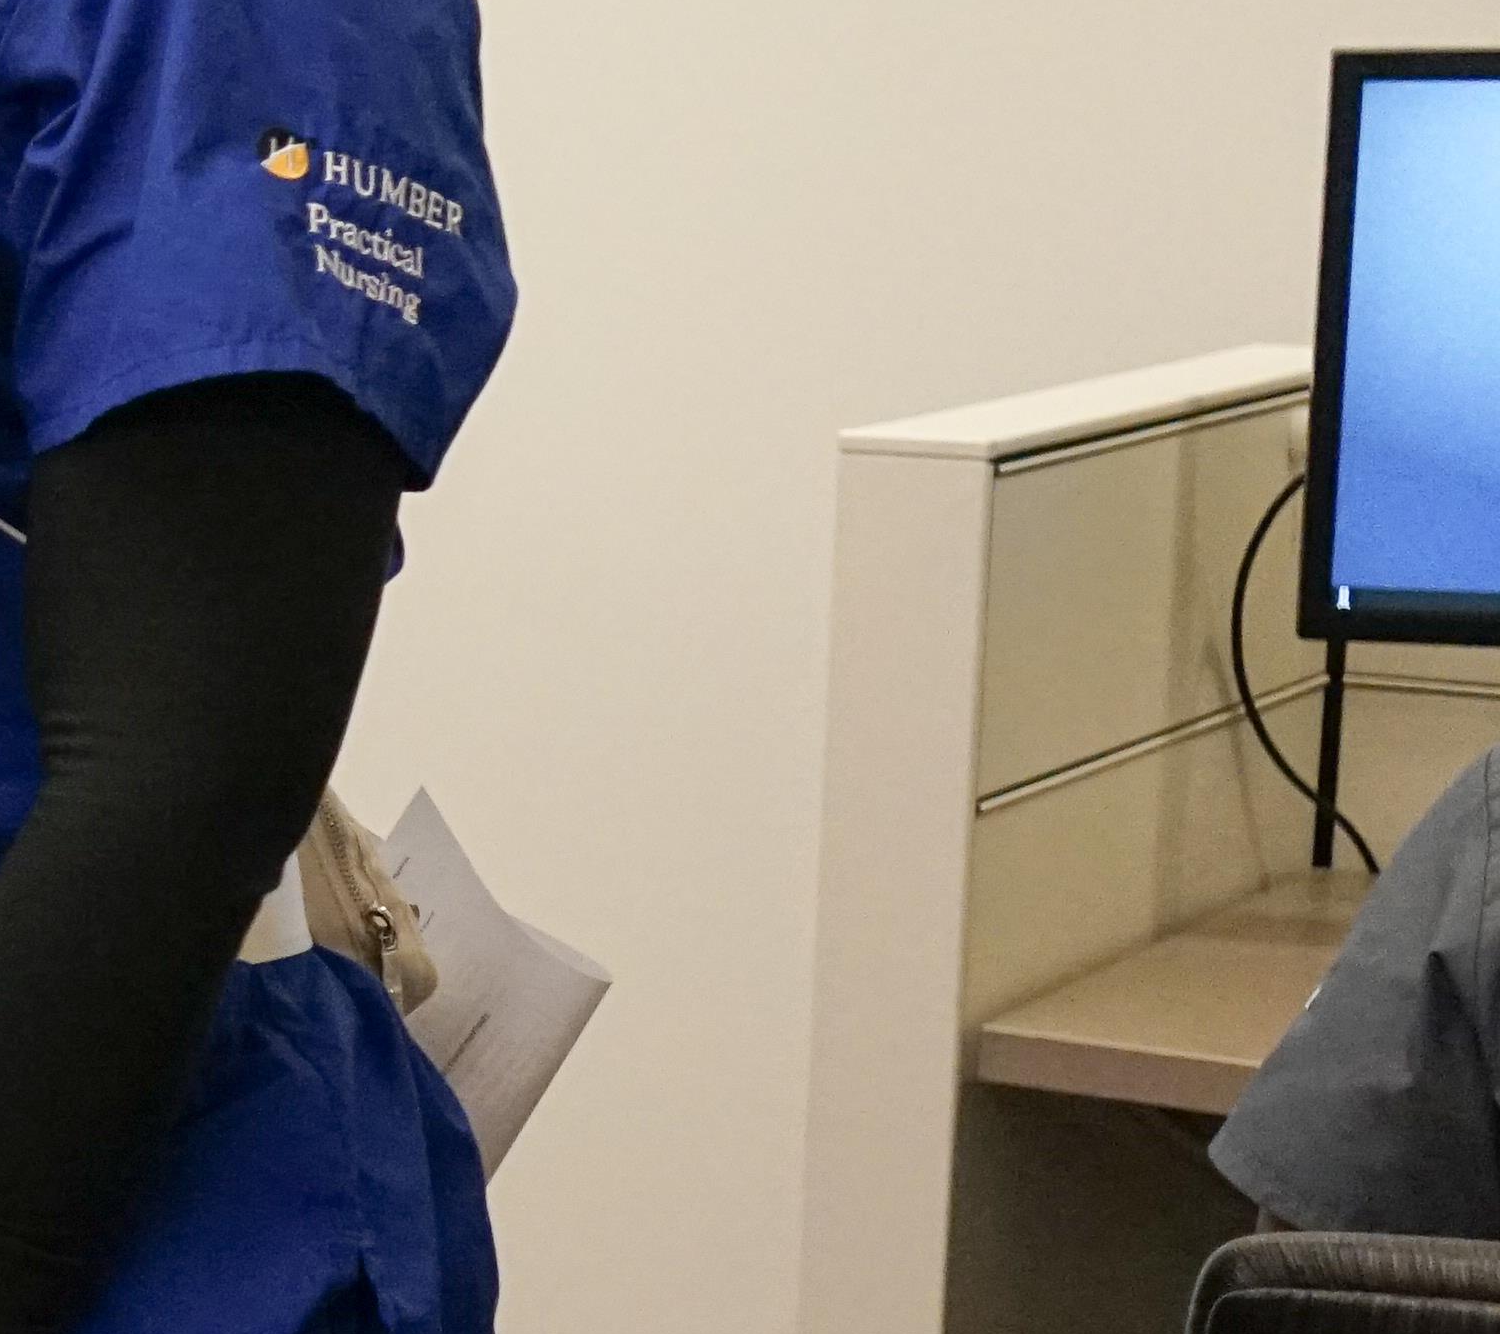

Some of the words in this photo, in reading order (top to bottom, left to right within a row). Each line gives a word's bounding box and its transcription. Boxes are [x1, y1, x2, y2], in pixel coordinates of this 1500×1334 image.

[323, 150, 465, 235] HUMBER
[306, 202, 425, 279] Practical
[313, 244, 422, 326] Nursing
